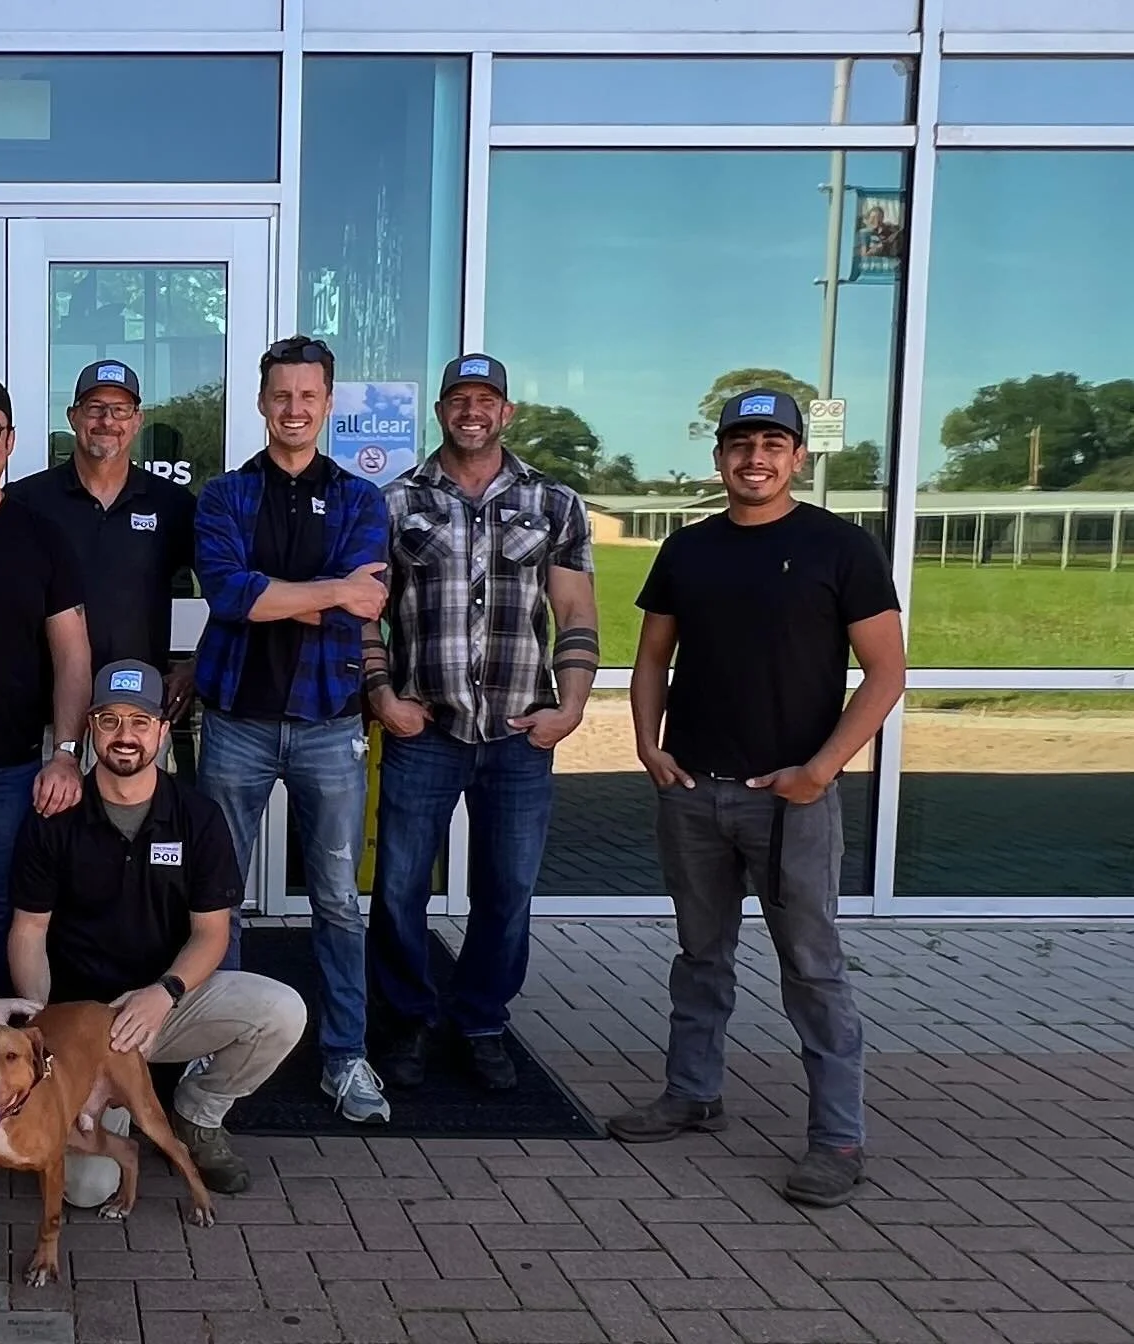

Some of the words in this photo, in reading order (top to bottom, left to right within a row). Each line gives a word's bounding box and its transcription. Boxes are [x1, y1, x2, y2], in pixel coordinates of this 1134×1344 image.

[465, 365, 487, 375] POD
[100, 371, 123, 380] POD
[744, 404, 771, 414] POD
[133, 520, 155, 529] POD
[114, 678, 139, 689] POD
[153, 852, 179, 863] POD
